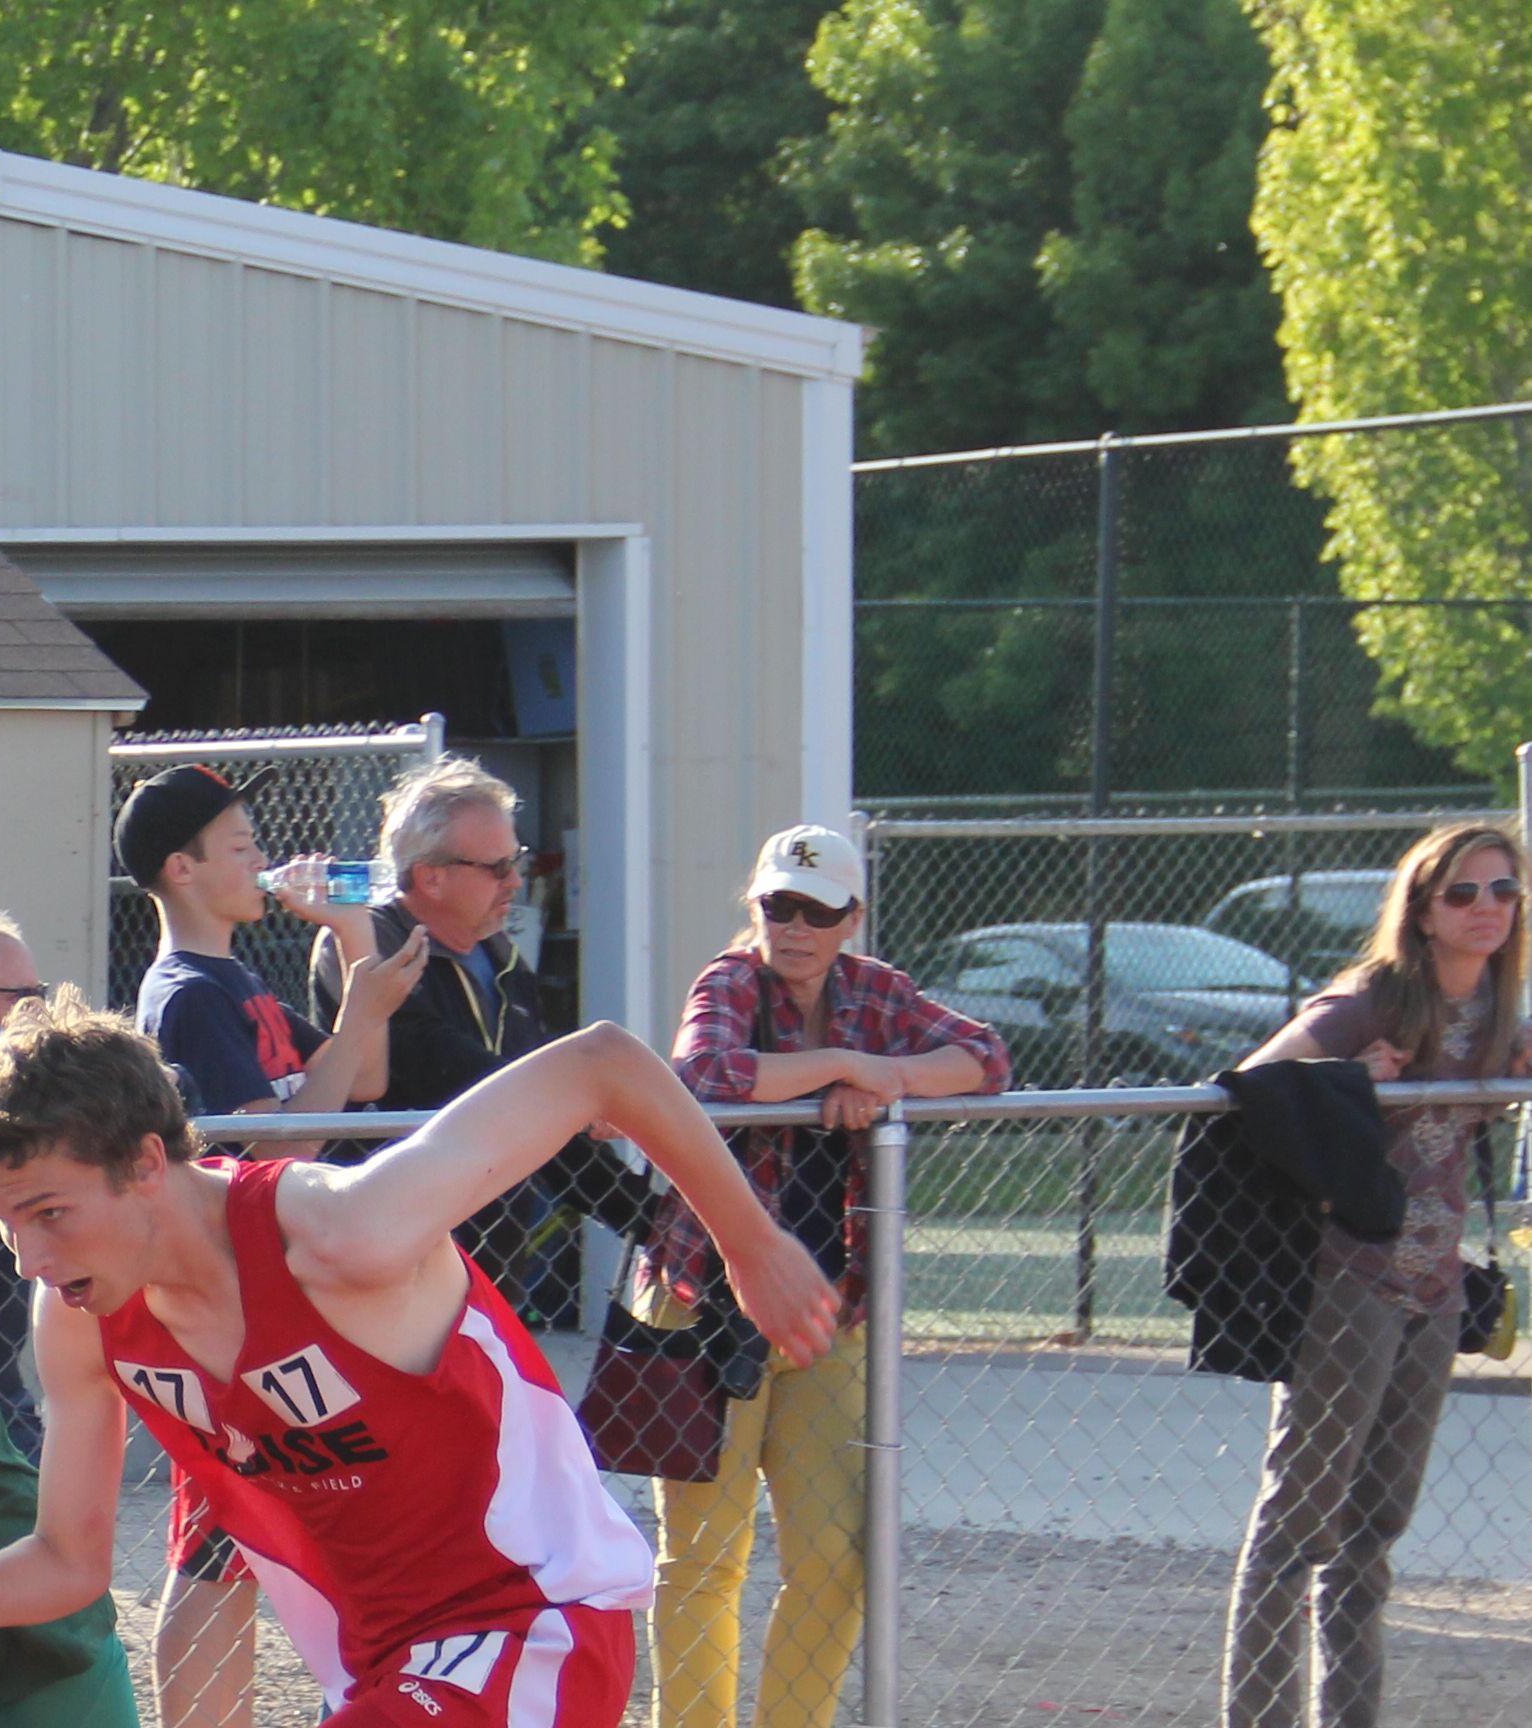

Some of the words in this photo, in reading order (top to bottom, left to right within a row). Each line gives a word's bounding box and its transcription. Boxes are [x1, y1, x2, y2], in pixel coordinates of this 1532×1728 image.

[133, 1369, 186, 1421] 17
[262, 1356, 328, 1423] 17
[411, 1688, 443, 1716] asics
